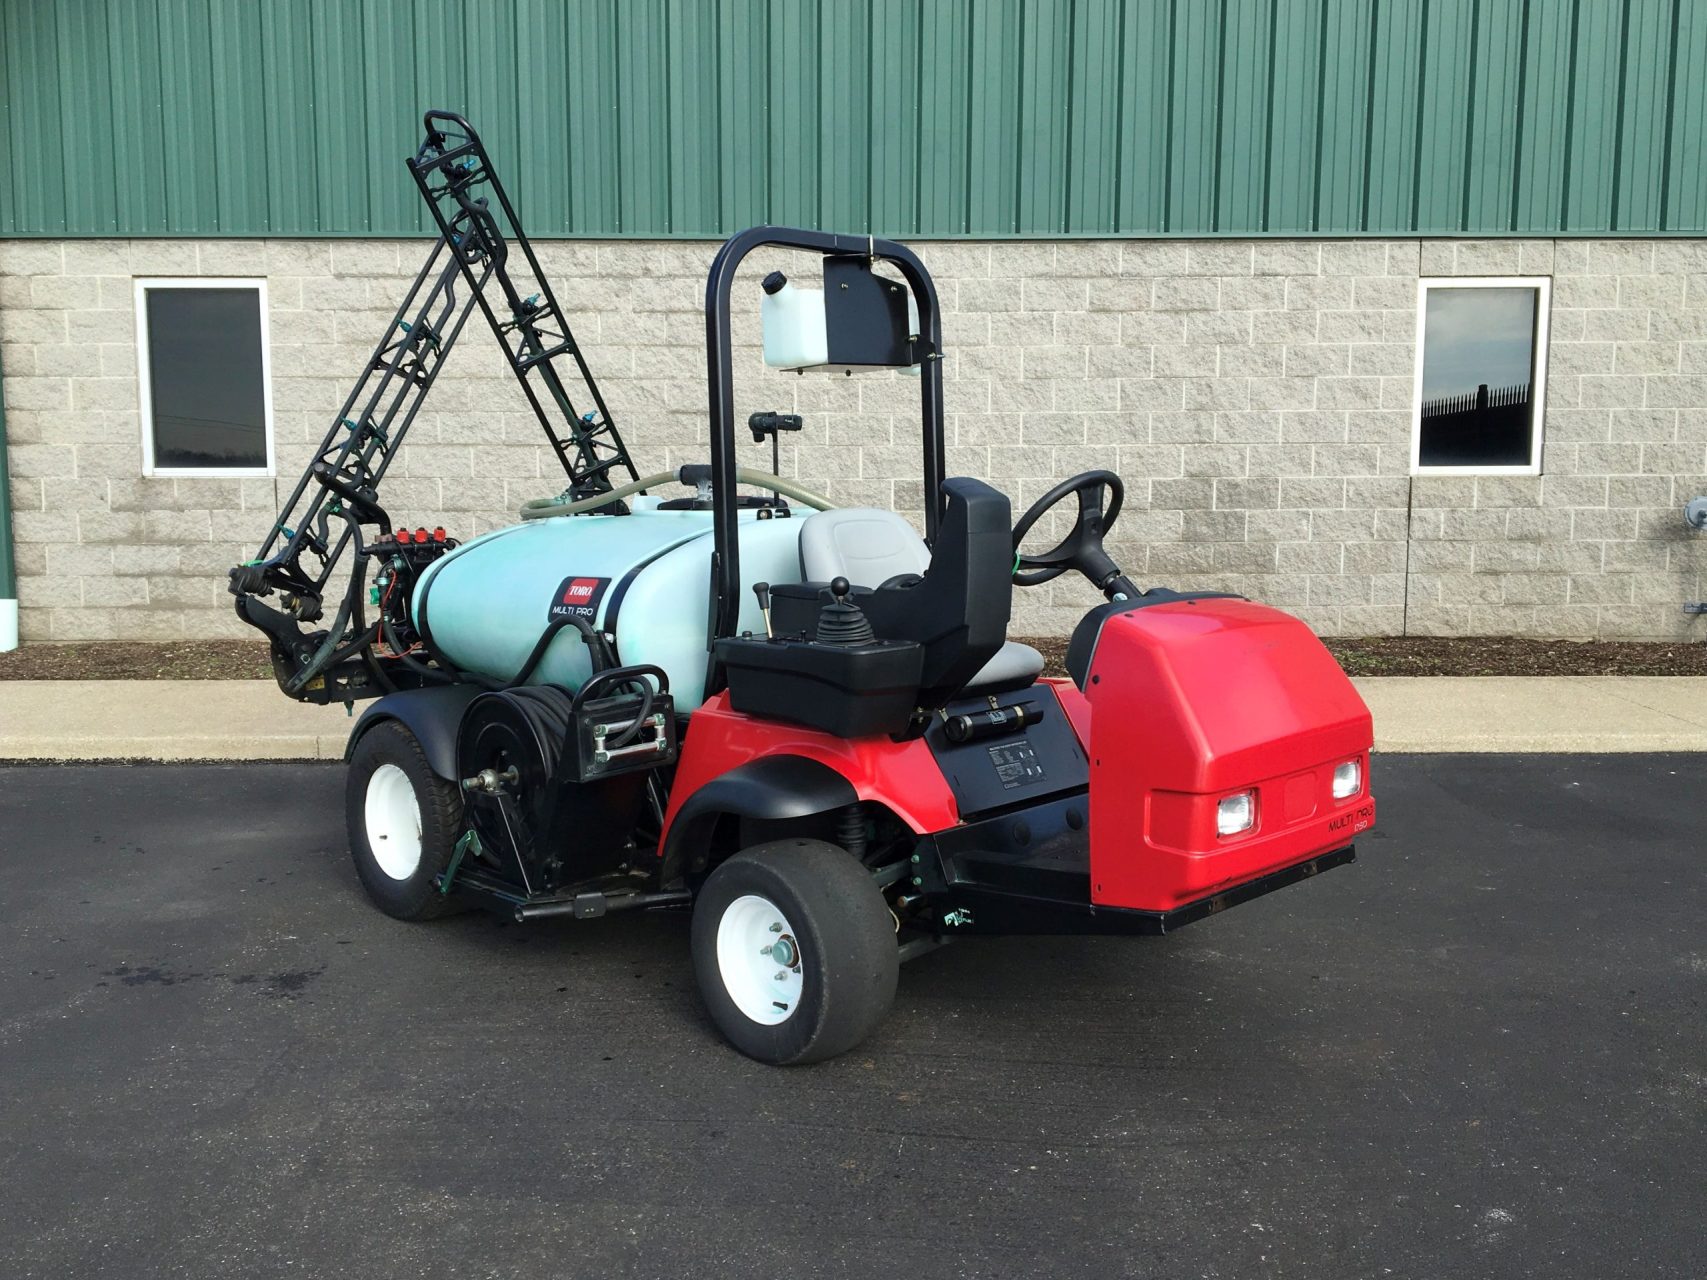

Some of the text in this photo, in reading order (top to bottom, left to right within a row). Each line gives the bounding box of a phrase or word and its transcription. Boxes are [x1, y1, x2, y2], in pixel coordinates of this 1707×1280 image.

[569, 585, 593, 596] TORO
[552, 606, 594, 616] MULTI PRO
[1328, 813, 1354, 833] MULTI
